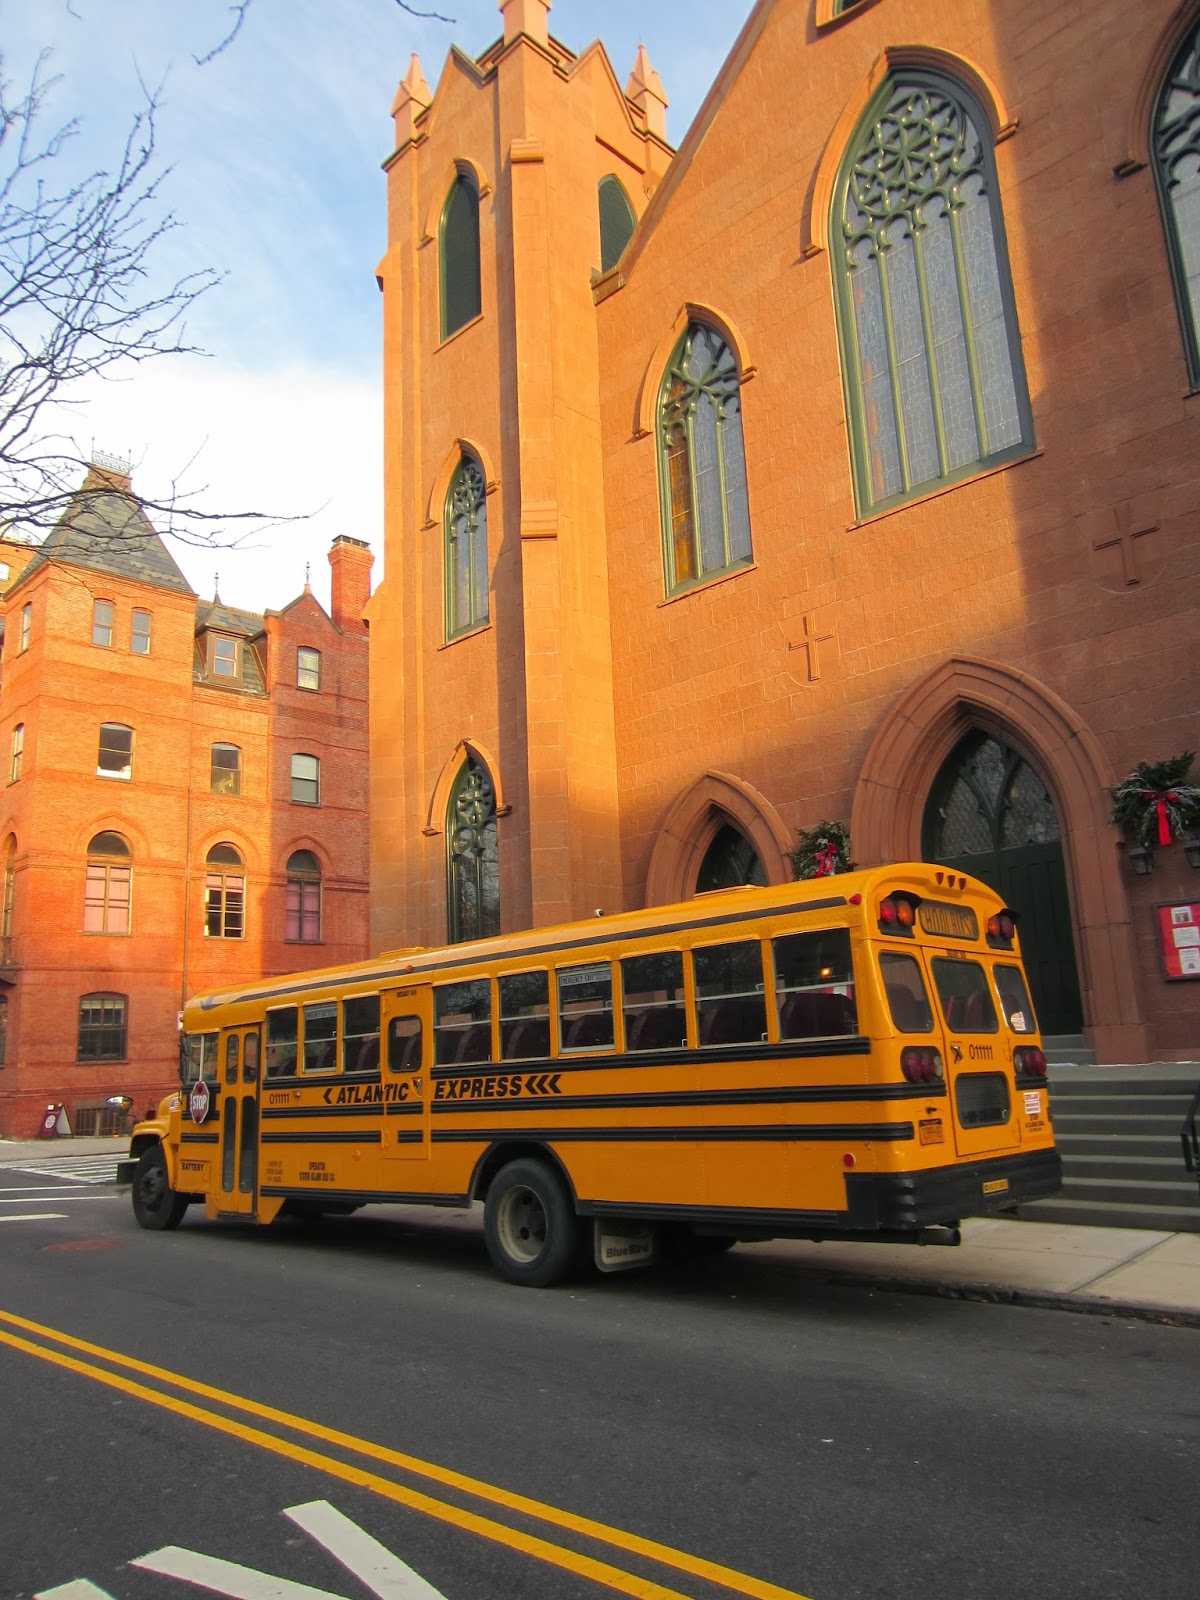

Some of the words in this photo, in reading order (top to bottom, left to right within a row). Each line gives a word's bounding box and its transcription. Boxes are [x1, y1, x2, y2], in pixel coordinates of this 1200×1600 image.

[968, 1043, 994, 1060] 011111
[336, 1083, 409, 1104] ATLANTIC
[434, 1076, 522, 1100] EXPRESS
[192, 1095, 207, 1110] STOP
[269, 1092, 290, 1105] 011111
[181, 1162, 204, 1172] BATTERY
